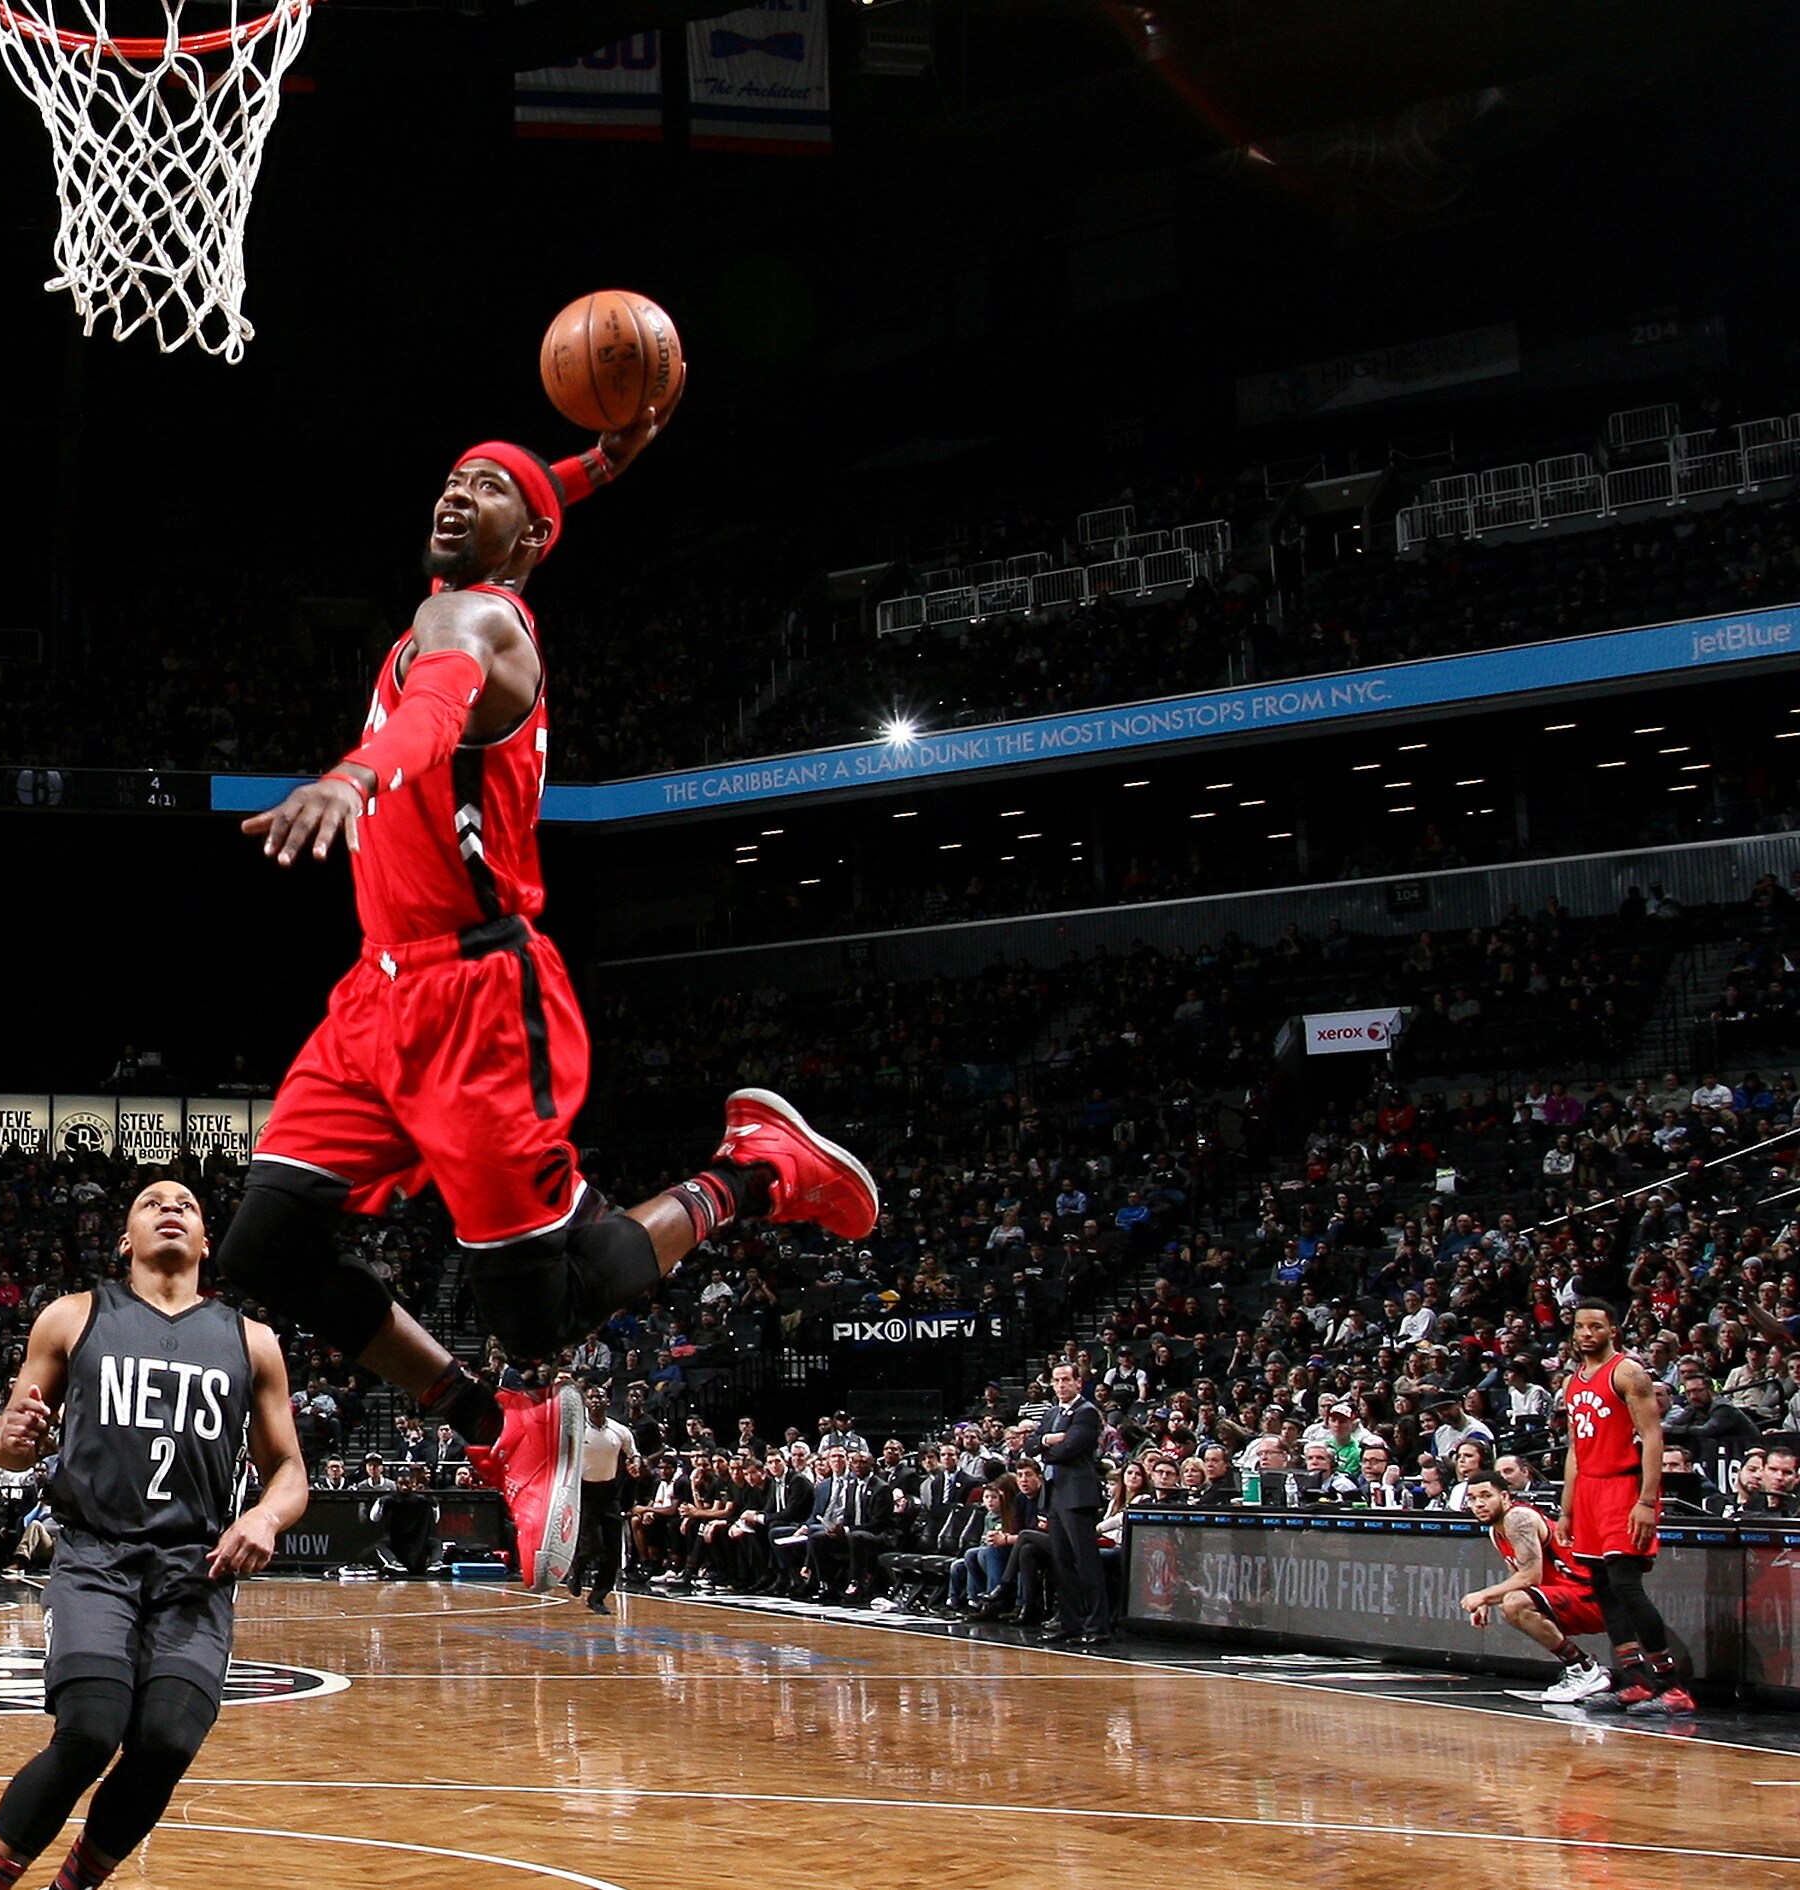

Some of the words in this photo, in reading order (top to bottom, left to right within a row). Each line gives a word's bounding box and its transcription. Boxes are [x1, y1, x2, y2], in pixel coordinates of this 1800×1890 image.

[1690, 622, 1793, 661] jetBlue
[663, 782, 698, 804] THE
[702, 762, 828, 798] CARIBBEAN?
[833, 764, 849, 780] A
[855, 749, 914, 776] SLAM
[920, 739, 991, 768] DUNK!
[995, 731, 1034, 756] THE
[1039, 720, 1105, 750] MOST
[1111, 702, 1246, 739] NONSTOPS
[1252, 691, 1326, 719] FROM
[1331, 679, 1393, 704] NYC.
[149, 777, 160, 790] 4
[1317, 1027, 1362, 1041] xerox
[120, 1113, 164, 1131] STEVE
[188, 1115, 232, 1133] STEVE
[120, 1131, 181, 1149] MADDEN
[188, 1132, 248, 1150] MADDEN
[100, 1355, 231, 1441] NETS
[1574, 1411, 1595, 1439] 24
[146, 1436, 176, 1500] 2
[285, 1534, 330, 1555] NOW
[1203, 1552, 1267, 1602] START
[1272, 1556, 1329, 1609] YOUR
[1337, 1561, 1396, 1615] FREE
